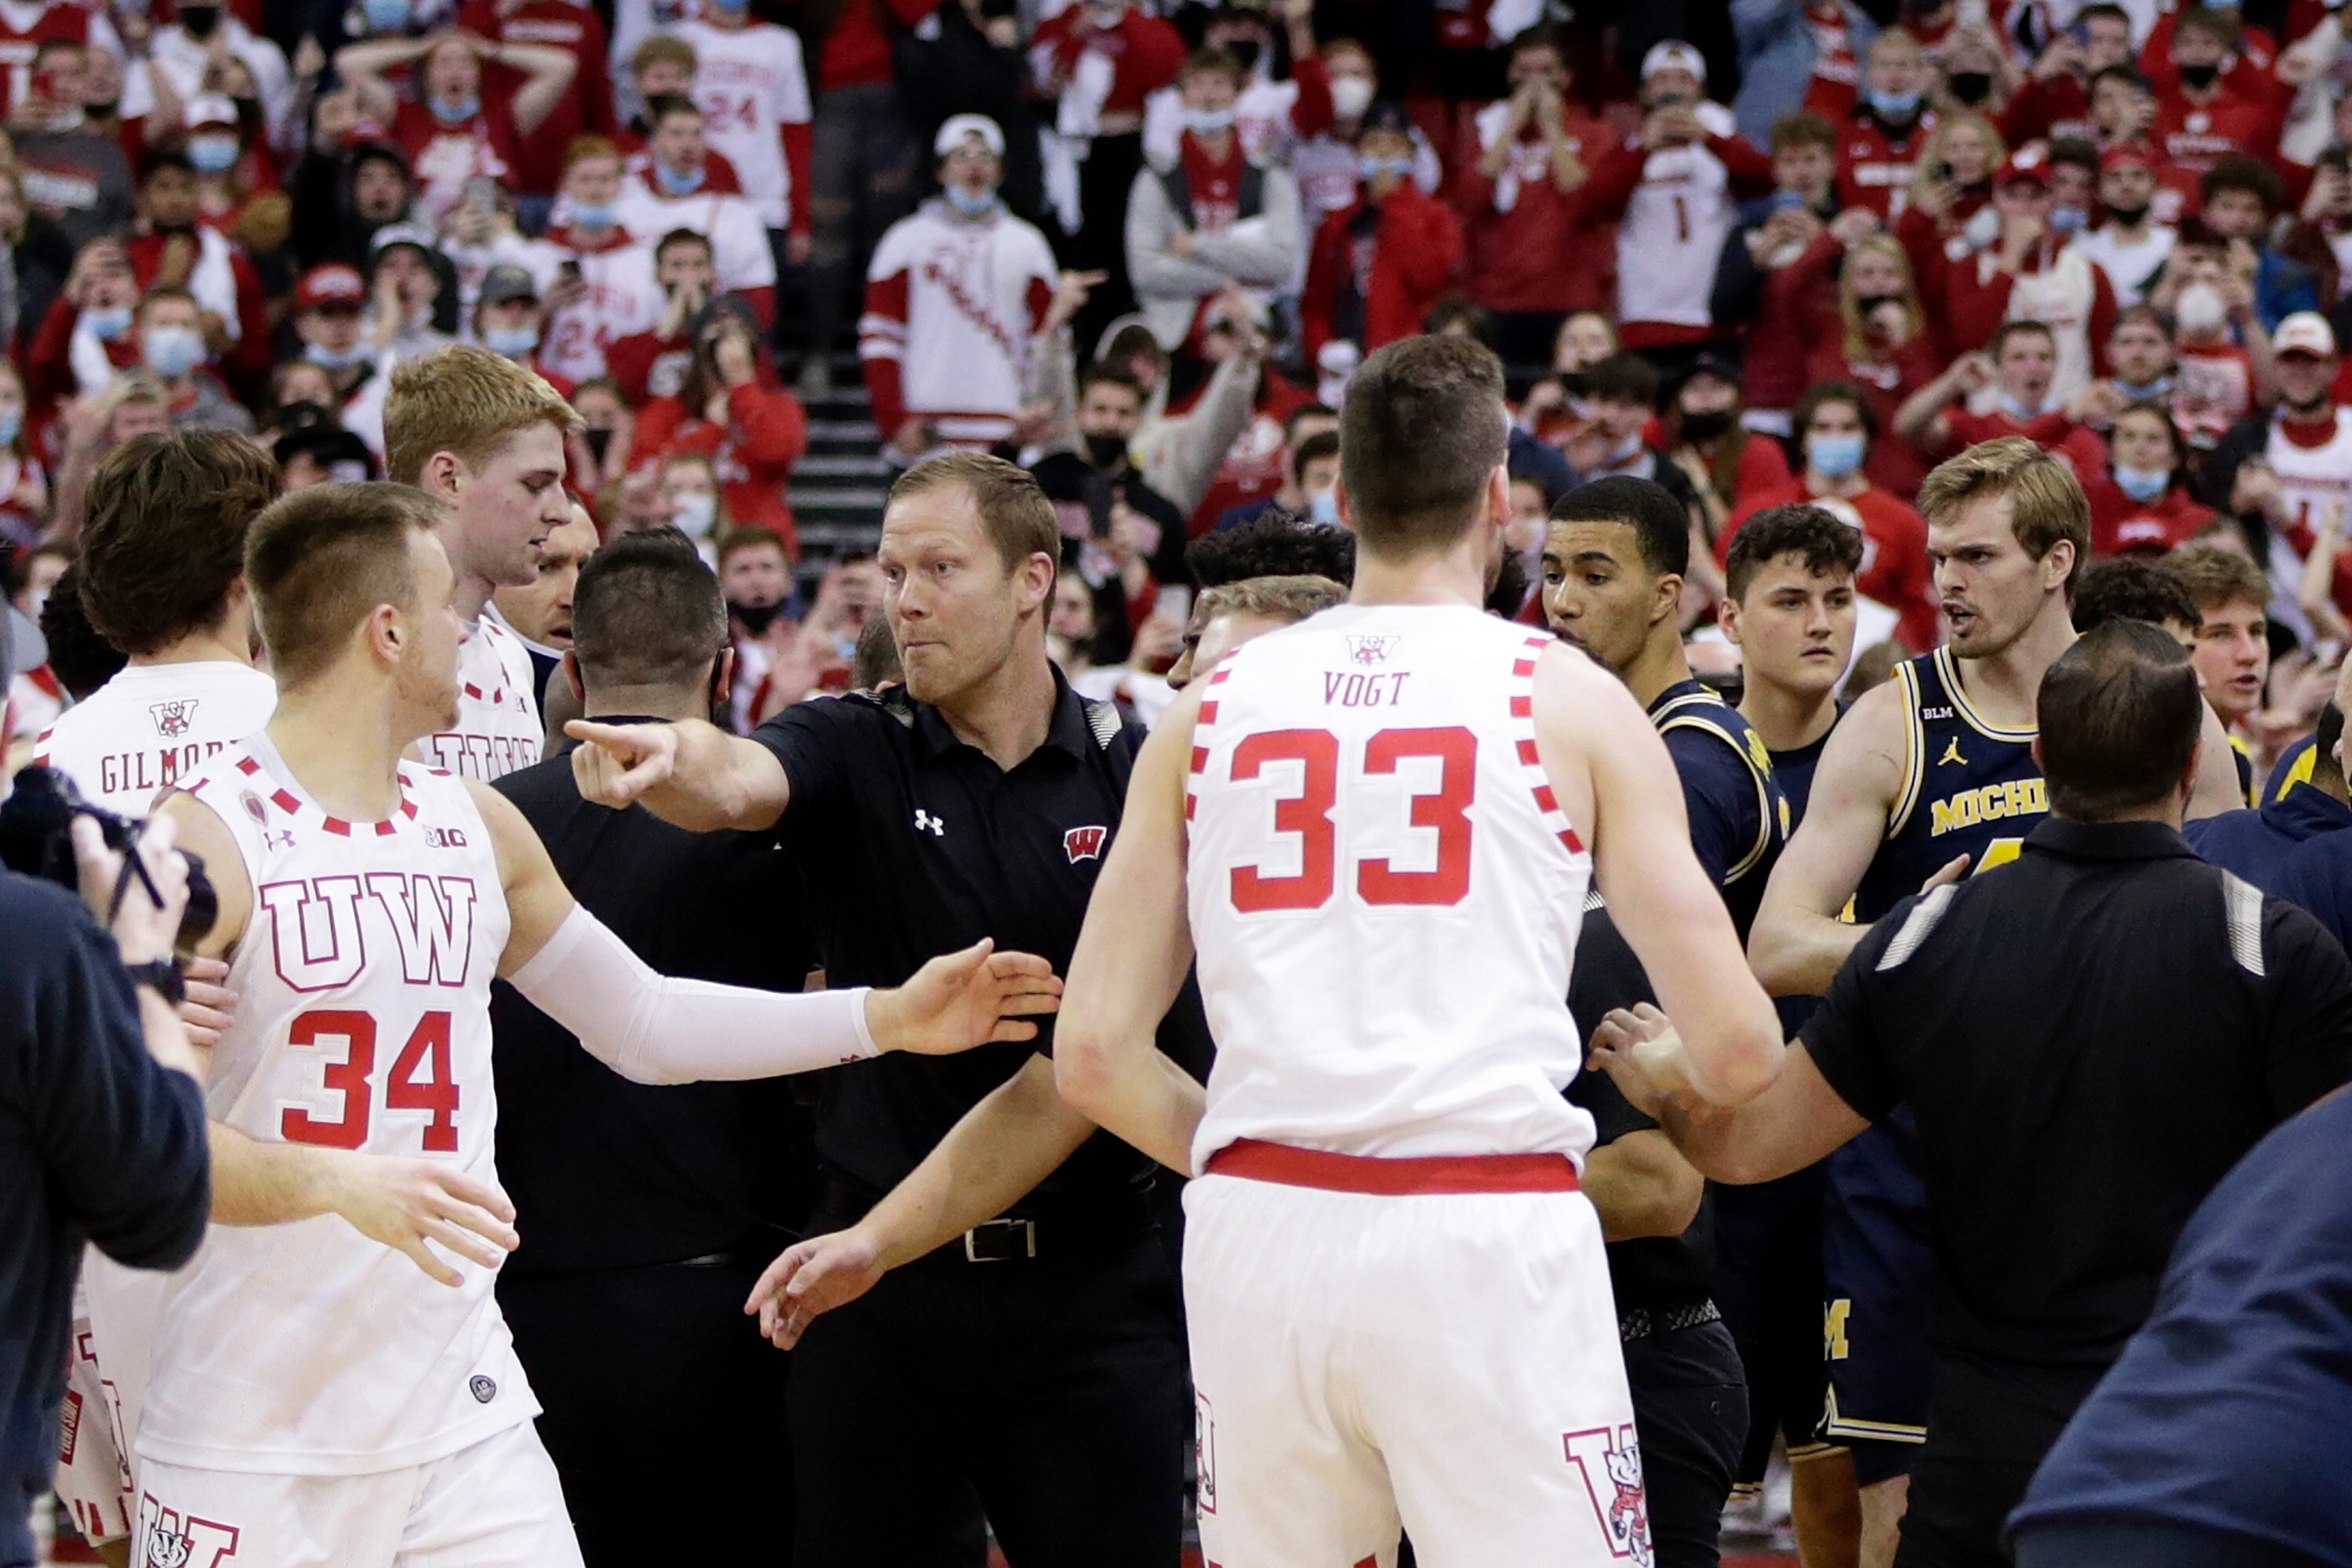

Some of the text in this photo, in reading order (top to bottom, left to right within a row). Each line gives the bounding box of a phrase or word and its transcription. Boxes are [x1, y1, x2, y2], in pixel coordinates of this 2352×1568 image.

[1323, 671, 1411, 707] VOGT
[1922, 706, 1954, 720] BLM
[1062, 825, 1108, 865] W
[1229, 725, 1479, 915] 33
[259, 872, 477, 993] UW
[281, 1009, 460, 1152] 34
